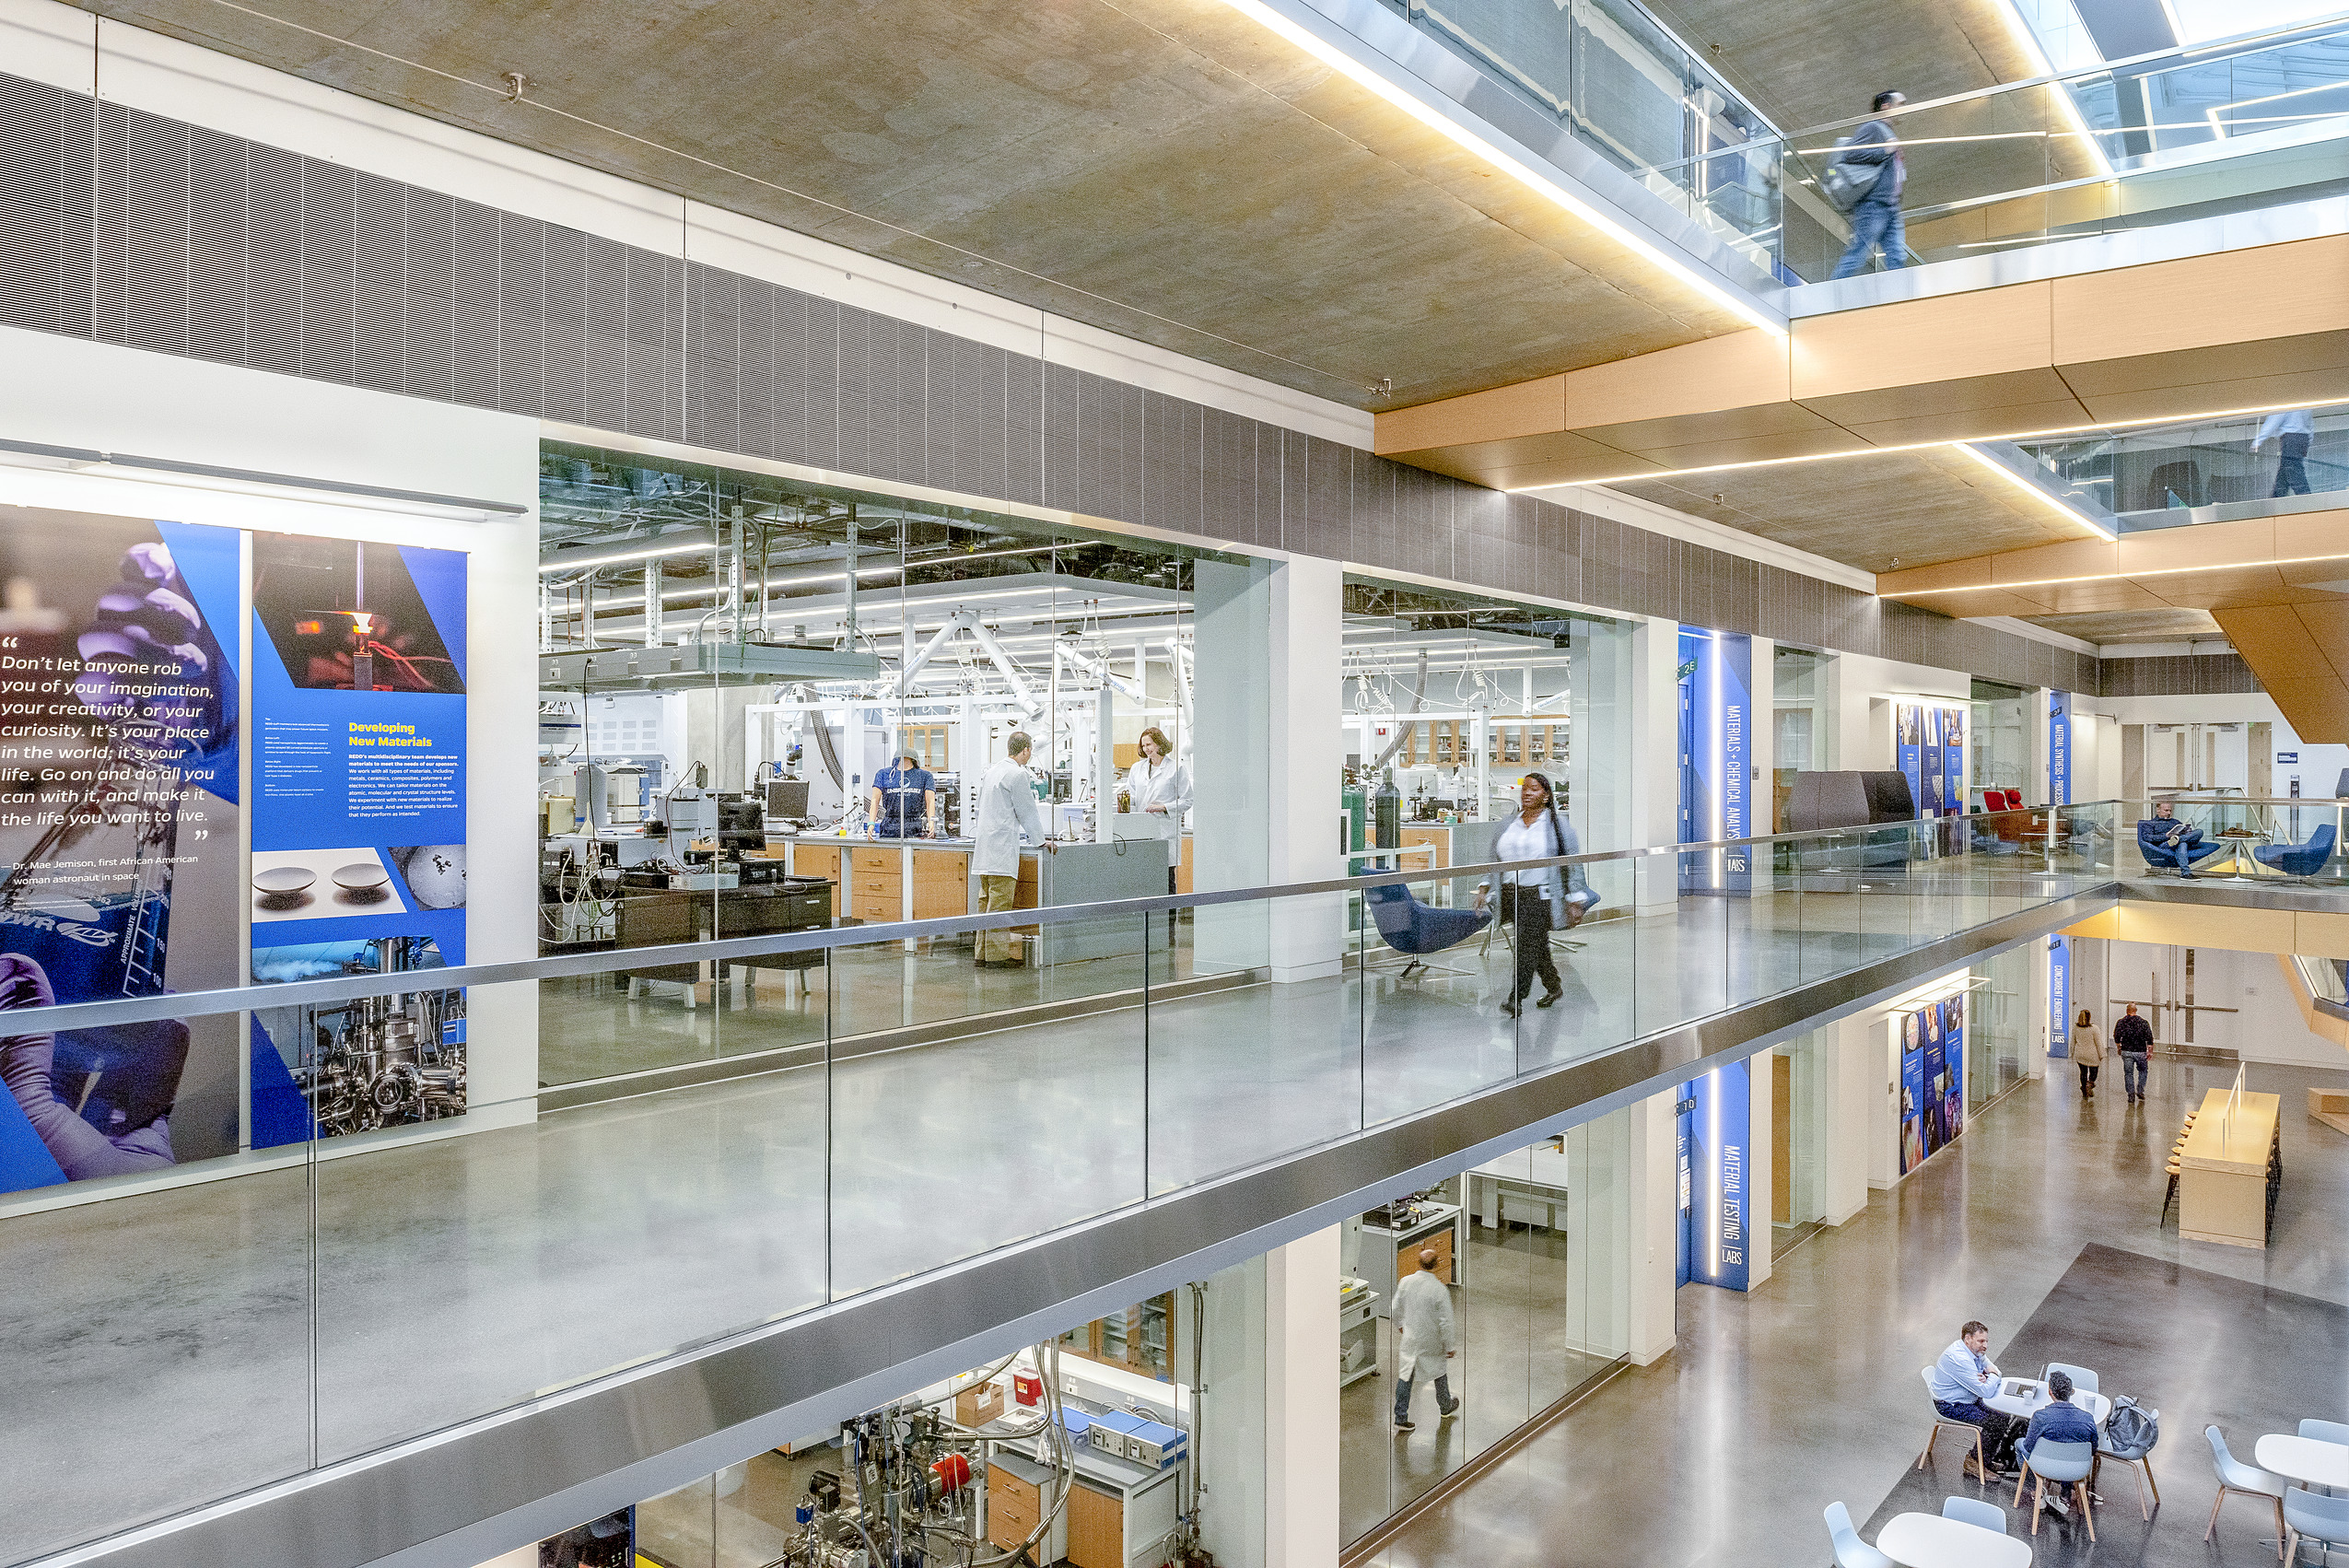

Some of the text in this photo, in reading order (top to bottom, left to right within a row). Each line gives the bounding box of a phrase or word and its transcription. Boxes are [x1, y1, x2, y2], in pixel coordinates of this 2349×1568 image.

[2, 656, 181, 675] Don’t let anyone rob
[1685, 661, 1694, 673] 2E
[1, 680, 214, 698] you of your imagination,
[1, 701, 203, 719] your creativity, or your
[1, 724, 209, 740] curiosity. It’s your place
[349, 722, 415, 734] Developing
[1727, 705, 1740, 752] MATERIALS
[2055, 725, 2063, 747] MATERIAL
[349, 737, 432, 746] New Materials
[1, 746, 186, 760] in the world; it’s your
[1, 768, 214, 781] life. Go on and do all you
[1727, 762, 1740, 802] CHEMICAL
[1, 789, 205, 803] can with it, and make it
[1, 811, 208, 826] the life you want to live.
[1727, 805, 1740, 839] ANALYS
[99, 858, 117, 866] first
[120, 857, 153, 866] African
[156, 856, 198, 864] American
[14, 876, 50, 884] woman
[53, 874, 99, 883] astronaut
[112, 872, 139, 881] space
[121, 915, 135, 964] APPROXIMATE
[1724, 1145, 1740, 1240] MATERIAL TESTING
[1723, 1249, 1742, 1265] LABS
